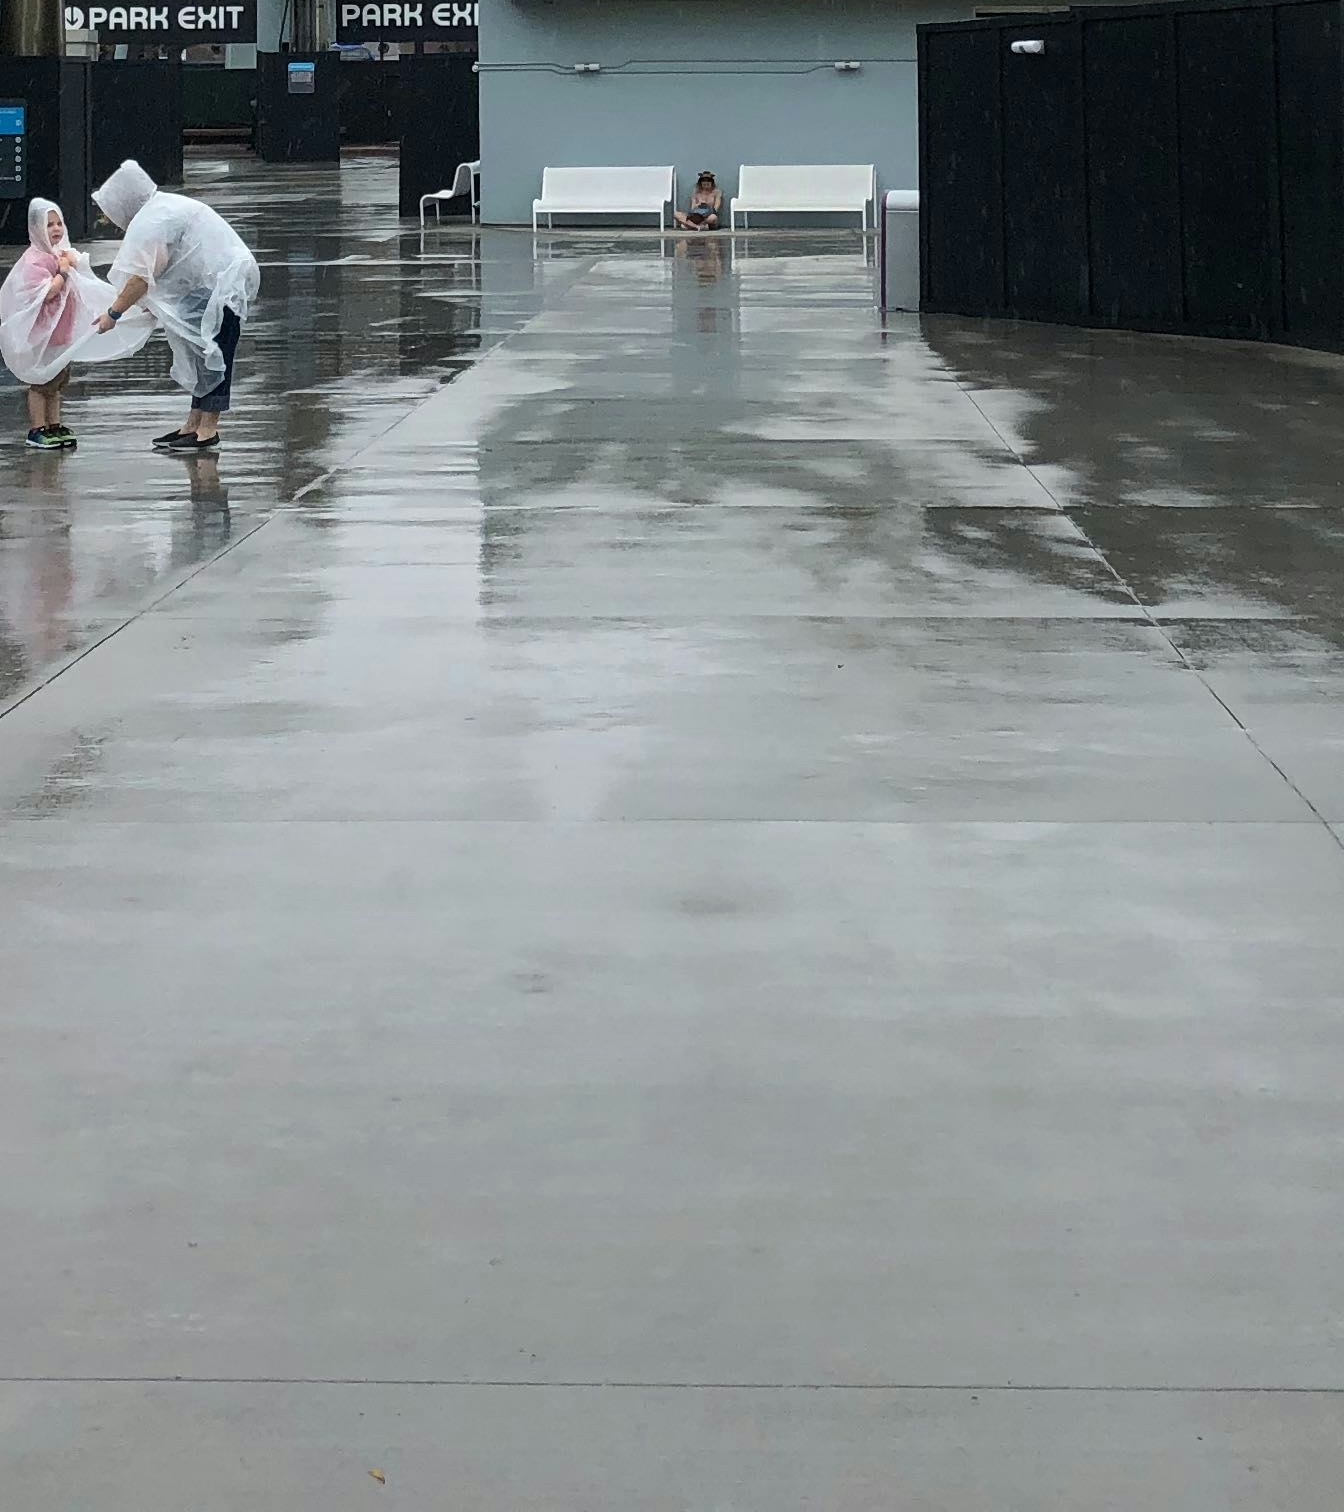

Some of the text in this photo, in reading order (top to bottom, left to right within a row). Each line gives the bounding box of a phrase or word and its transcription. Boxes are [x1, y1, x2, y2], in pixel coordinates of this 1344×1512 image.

[89, 6, 244, 30] PARK EXIT
[341, 3, 479, 27] PARK EXI
